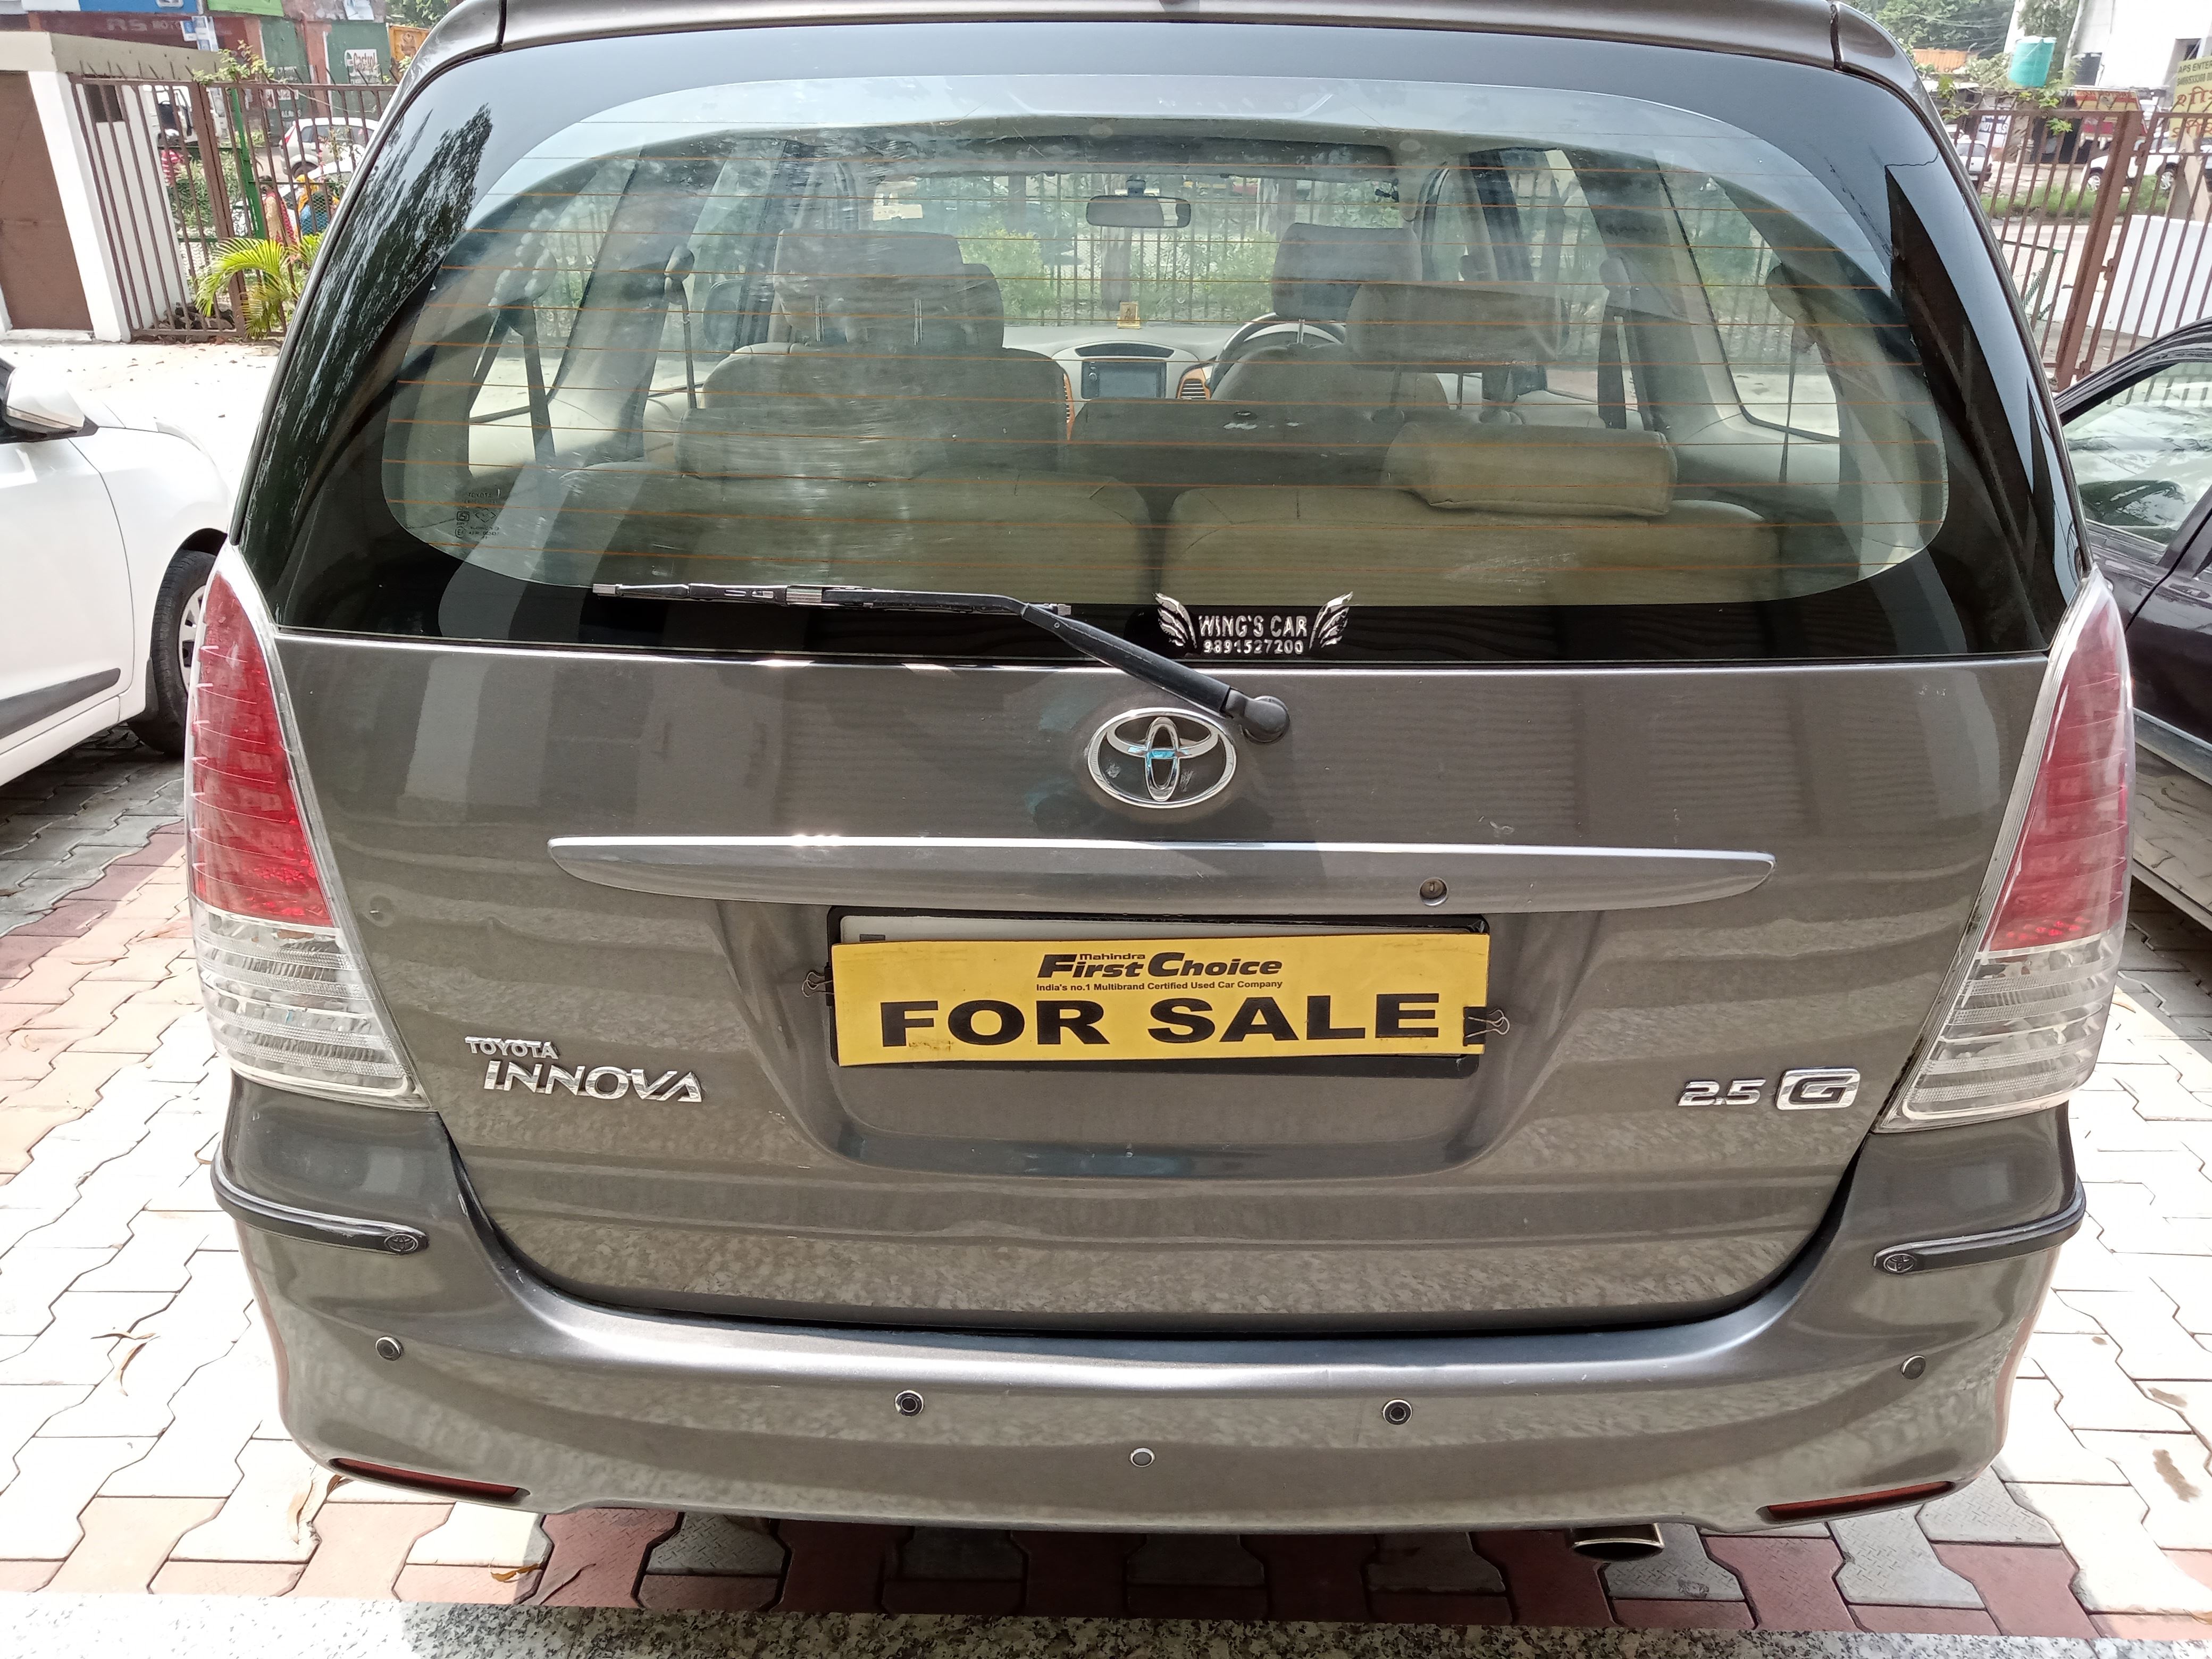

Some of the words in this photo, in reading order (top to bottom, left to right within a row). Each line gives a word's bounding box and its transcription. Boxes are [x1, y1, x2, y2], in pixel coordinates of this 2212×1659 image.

[1199, 615, 1264, 637] WING'S
[1270, 615, 1307, 637] CAR
[1203, 639, 1303, 655] 9891527200
[1037, 954, 1144, 978] First
[1147, 952, 1283, 977] Choice
[1237, 981, 1283, 989] Company
[881, 1000, 1110, 1047] FOR
[1147, 993, 1439, 1043] SALE
[465, 1036, 559, 1060] TOYOTA
[483, 1060, 702, 1102] INNOVA
[1677, 1079, 1766, 1107] 2.5
[1775, 1068, 1861, 1110] G
